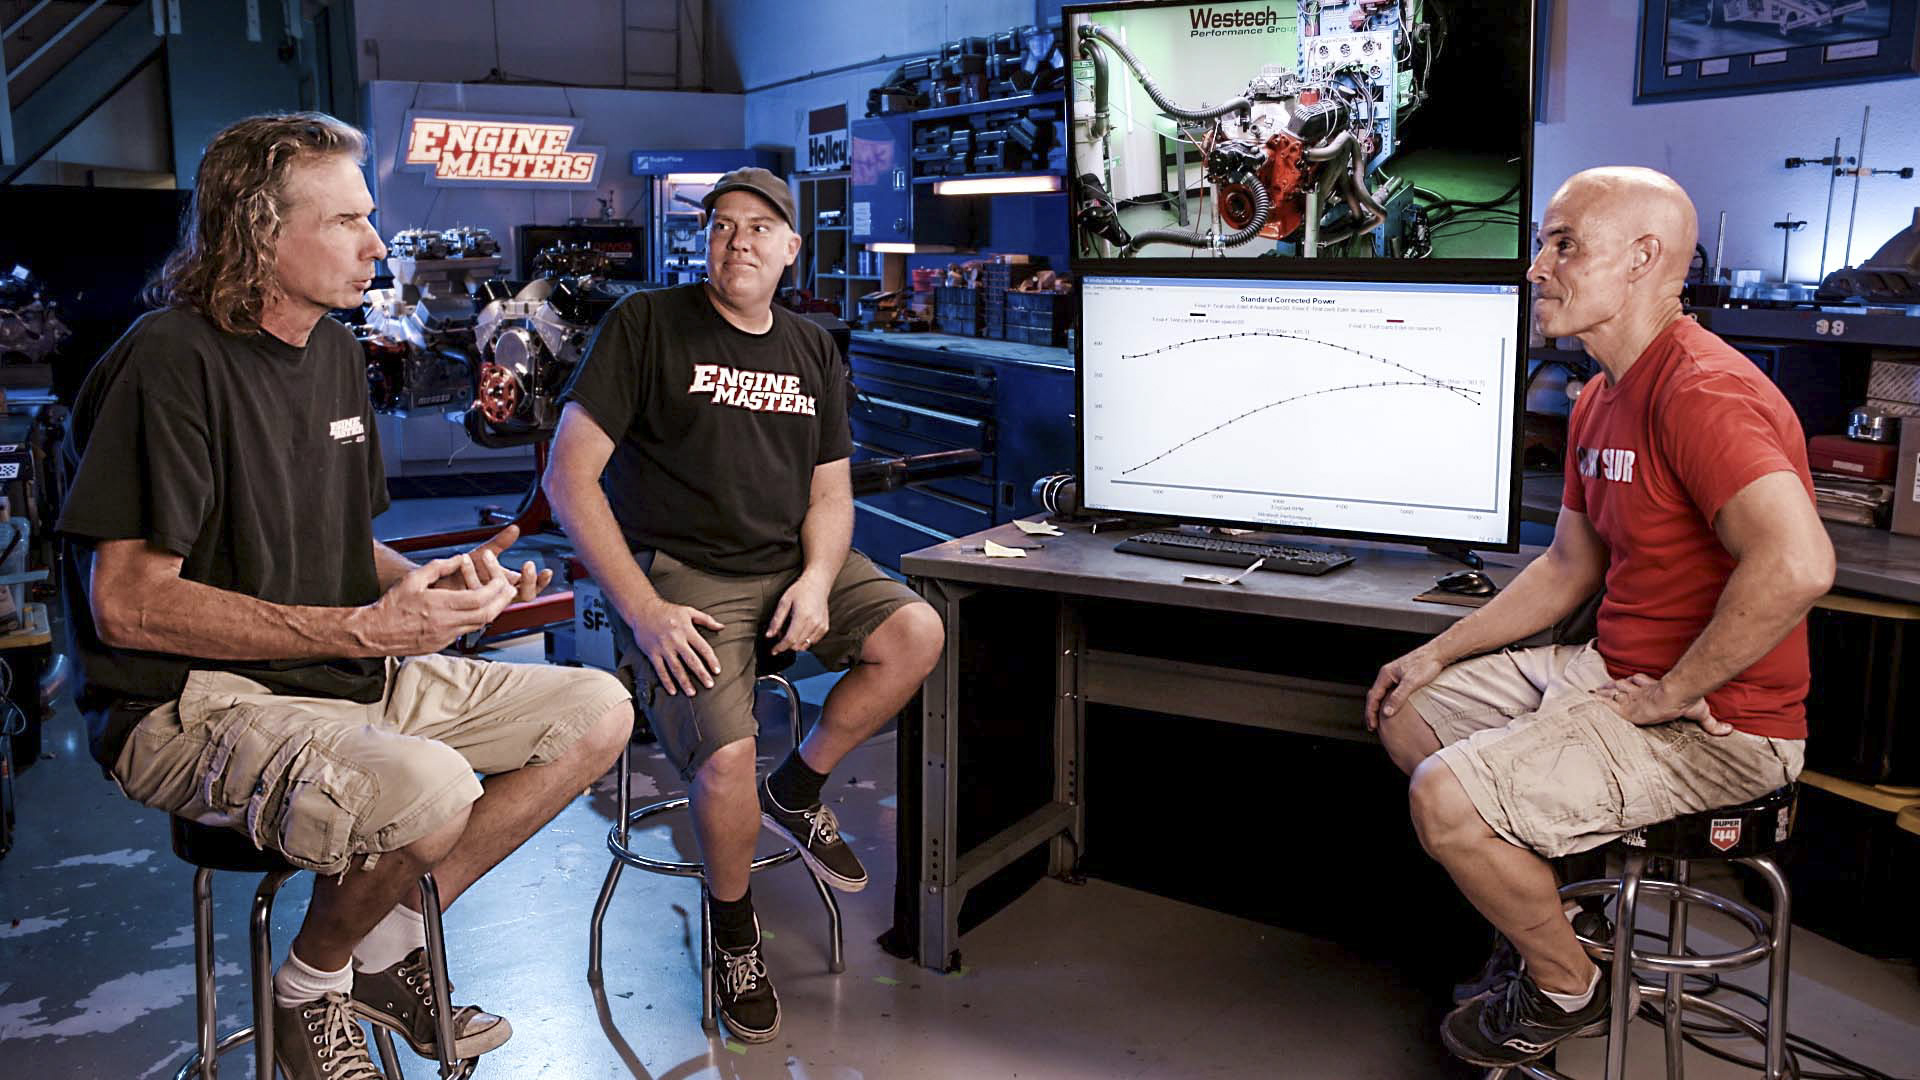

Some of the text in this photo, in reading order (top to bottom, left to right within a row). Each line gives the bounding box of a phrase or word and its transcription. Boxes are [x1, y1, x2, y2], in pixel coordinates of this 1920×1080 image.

[1189, 5, 1277, 29] Westech
[1190, 27, 1263, 38] Performance
[407, 121, 570, 162] ENGINE
[808, 134, 848, 168] Holley
[436, 152, 593, 180] MASTERS
[1240, 295, 1336, 305] Standard Corrected Power
[688, 364, 801, 393] ENGINE
[711, 385, 816, 416] MASTERS
[1712, 819, 1741, 828] SUPER
[1713, 829, 1737, 843] 44
